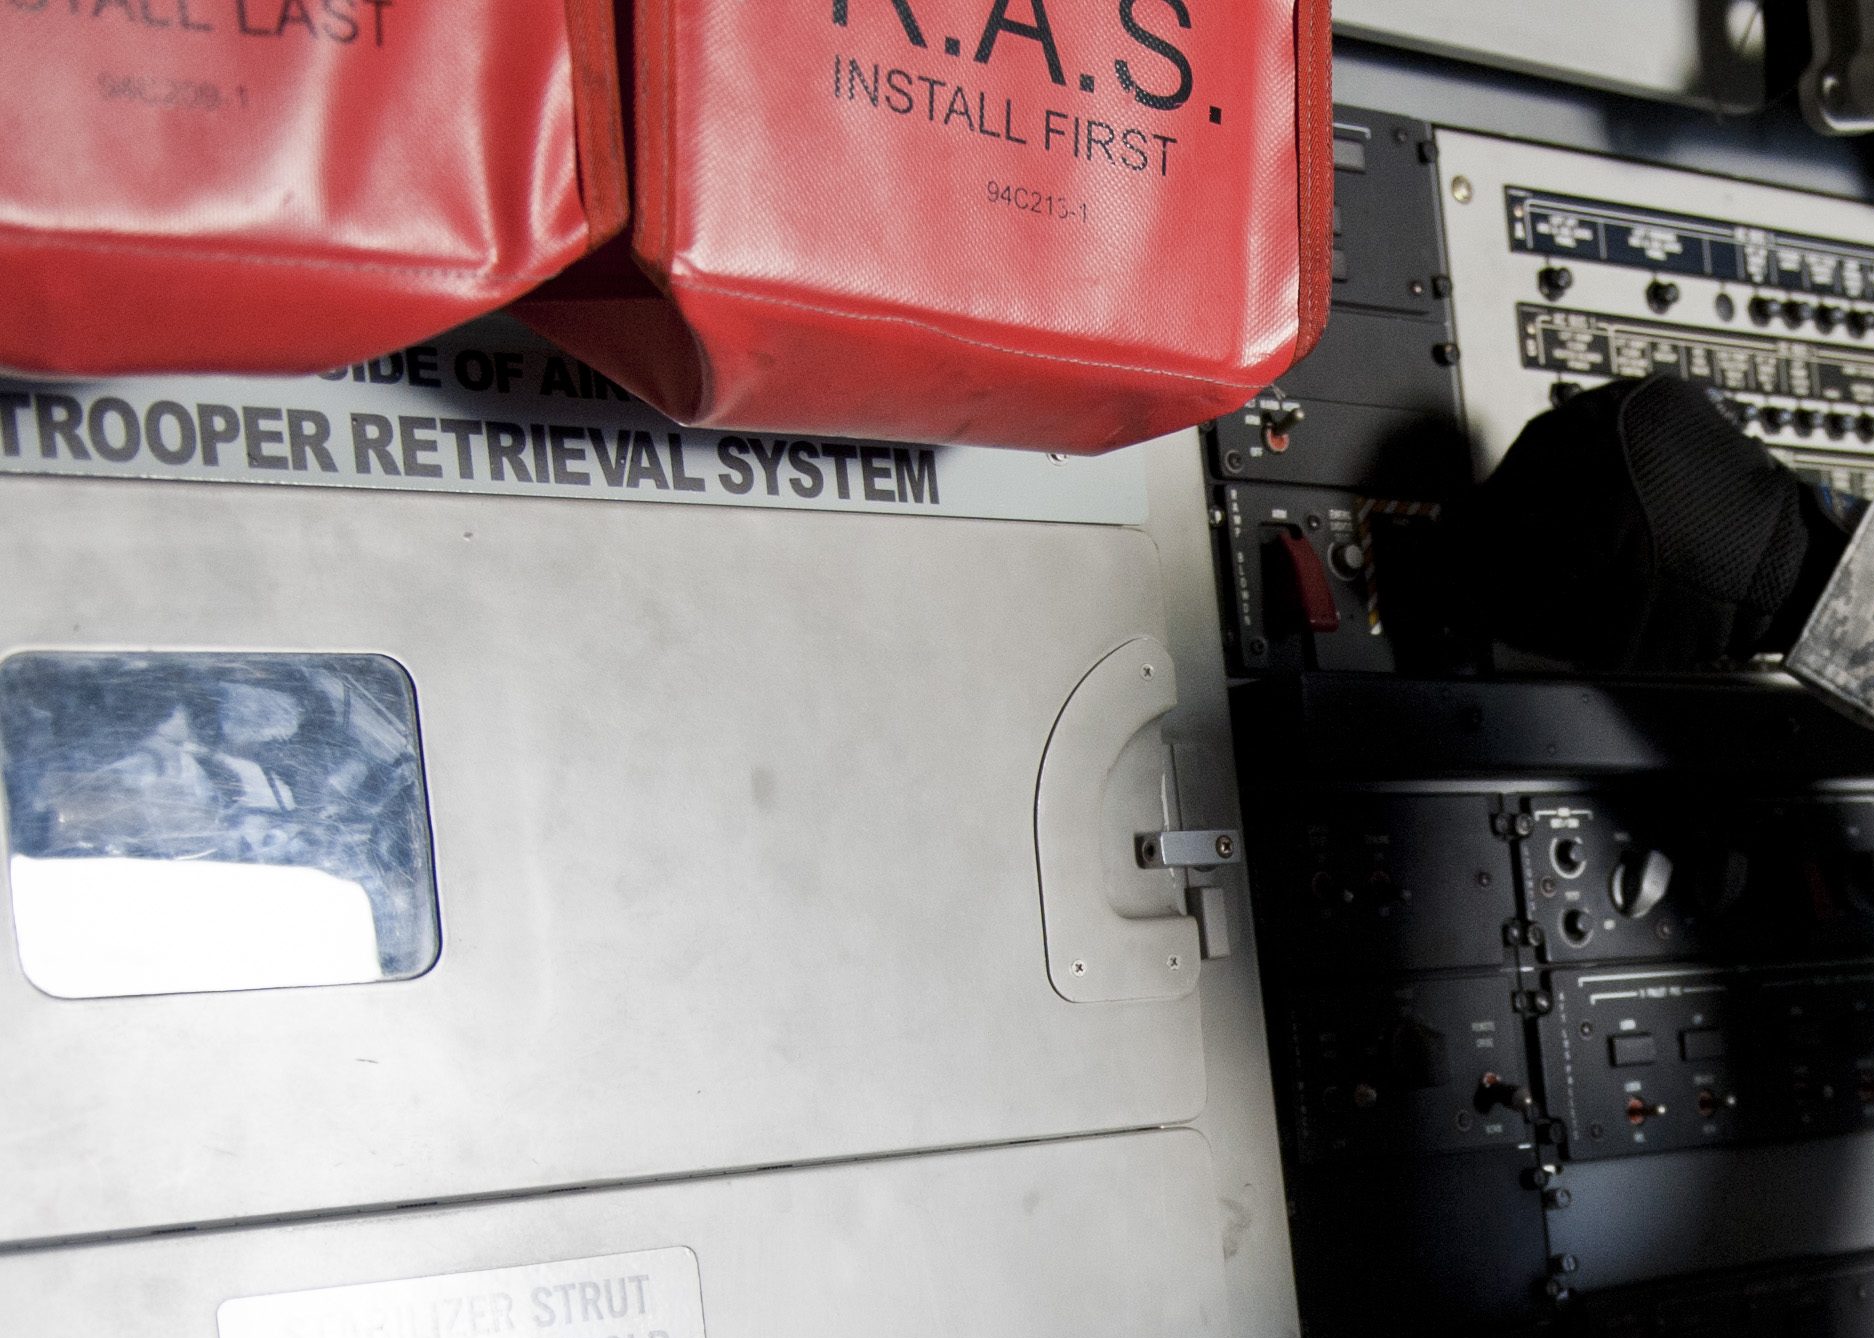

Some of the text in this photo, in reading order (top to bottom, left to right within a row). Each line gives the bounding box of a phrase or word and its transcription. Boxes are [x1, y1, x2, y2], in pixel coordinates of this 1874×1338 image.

[238, 0, 393, 47] LAST
[833, 55, 1178, 177] INSTALL FIRST
[454, 349, 523, 394] OF
[0, 392, 940, 504] TROOPER RETRIEVAL SYSTEM
[531, 1274, 650, 1328] STRUT
